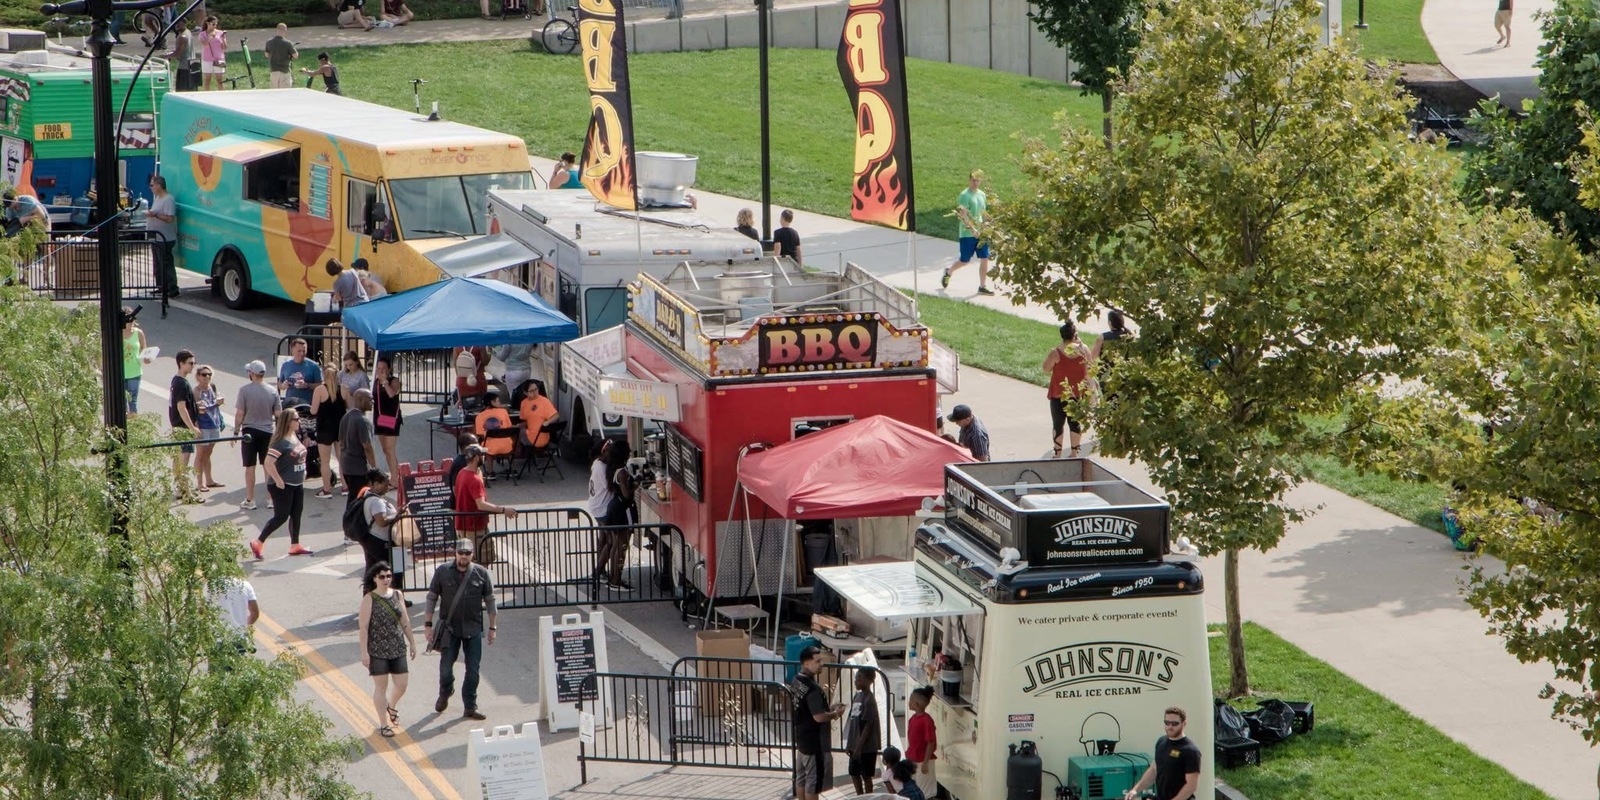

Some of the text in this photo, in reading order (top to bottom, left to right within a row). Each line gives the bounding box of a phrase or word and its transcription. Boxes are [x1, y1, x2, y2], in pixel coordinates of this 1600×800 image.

[42, 131, 65, 140] TRUCK
[44, 124, 62, 132] FOOD
[766, 325, 871, 364] BBQ
[620, 382, 653, 392] GLASS CITY
[947, 476, 975, 511] JOHNSON'S
[996, 511, 1011, 530] CREAM
[1054, 517, 1138, 542] JOHNSON'S
[1047, 548, 1144, 560] johnsonsrealicecream.com
[1047, 580, 1065, 594] Real
[1065, 578, 1078, 588] Ice
[1112, 576, 1154, 597] Since 1950
[1018, 609, 1178, 626] We cater private & corporate events!
[1022, 646, 1179, 693] JOHNSON'S
[1055, 686, 1142, 699] REAL ICE CREAM
